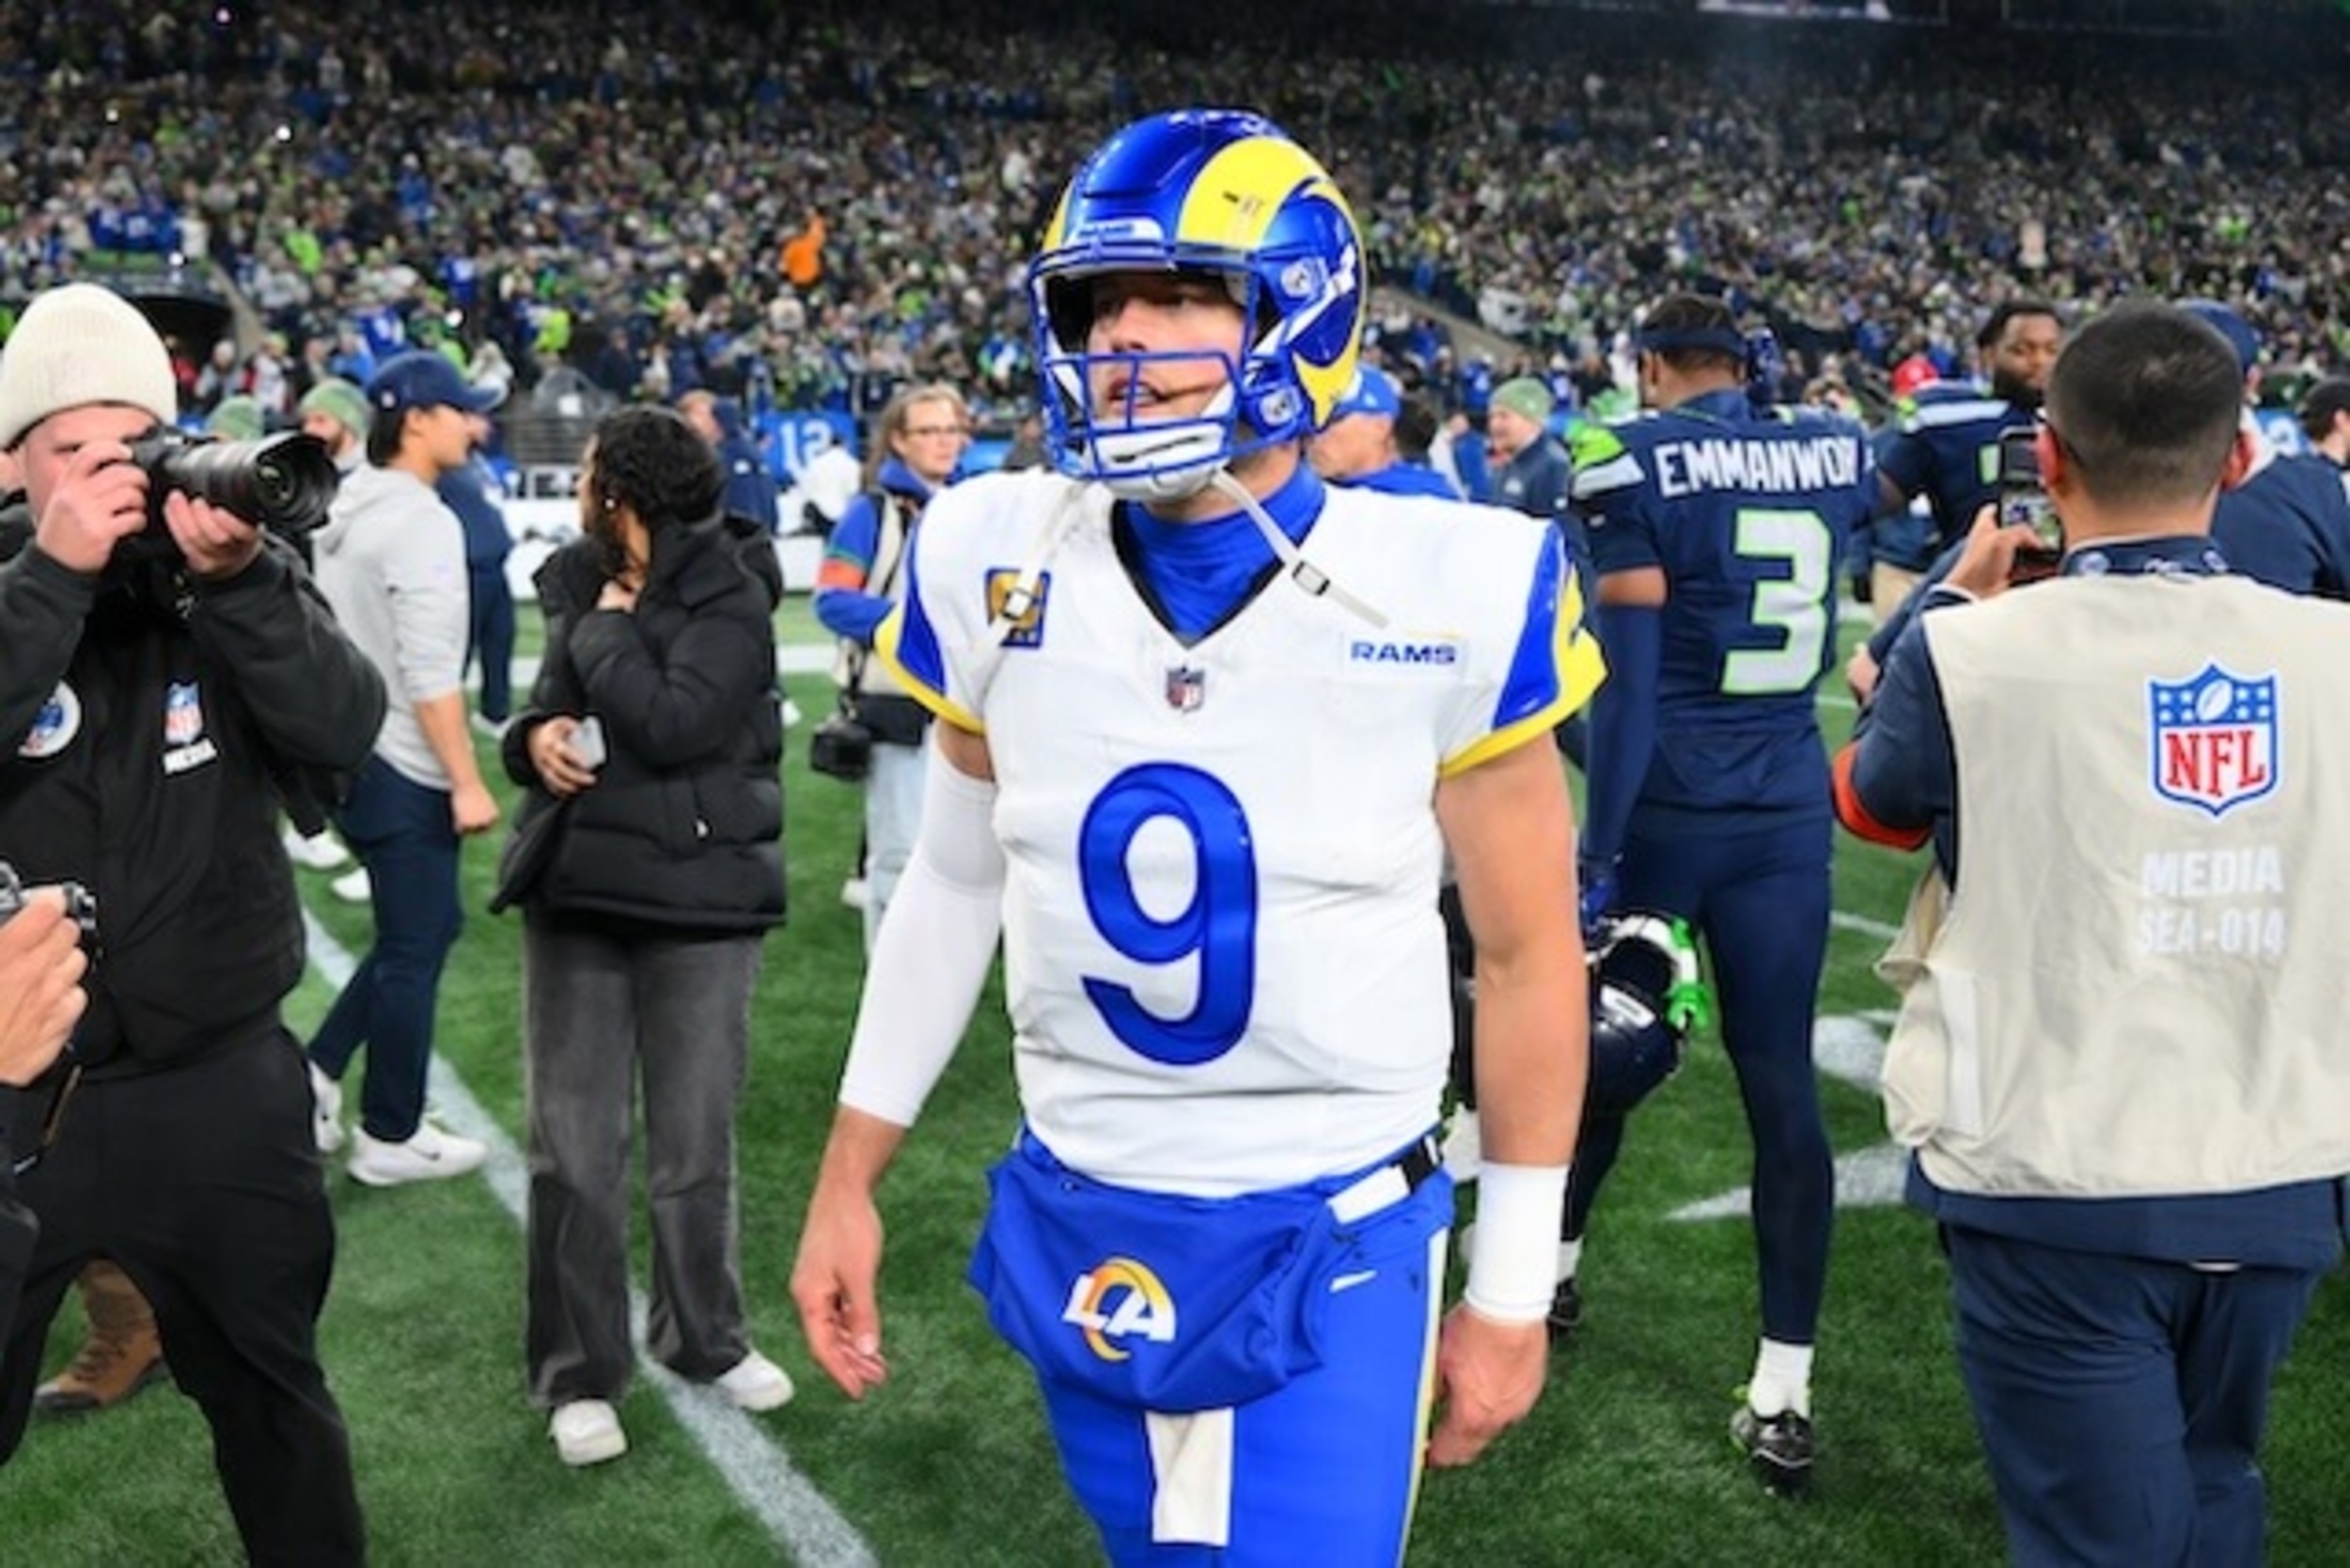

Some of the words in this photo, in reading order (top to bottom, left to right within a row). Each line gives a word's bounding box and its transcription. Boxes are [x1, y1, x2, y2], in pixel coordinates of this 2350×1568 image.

[781, 419, 832, 472] 12
[1721, 509, 1832, 695] 3
[1351, 642, 1456, 665] RAMS
[2166, 729, 2265, 797] NFL
[2142, 847, 2285, 897] MEDIA
[1078, 761, 1259, 1066] 9
[1061, 1256, 1177, 1361] LA
